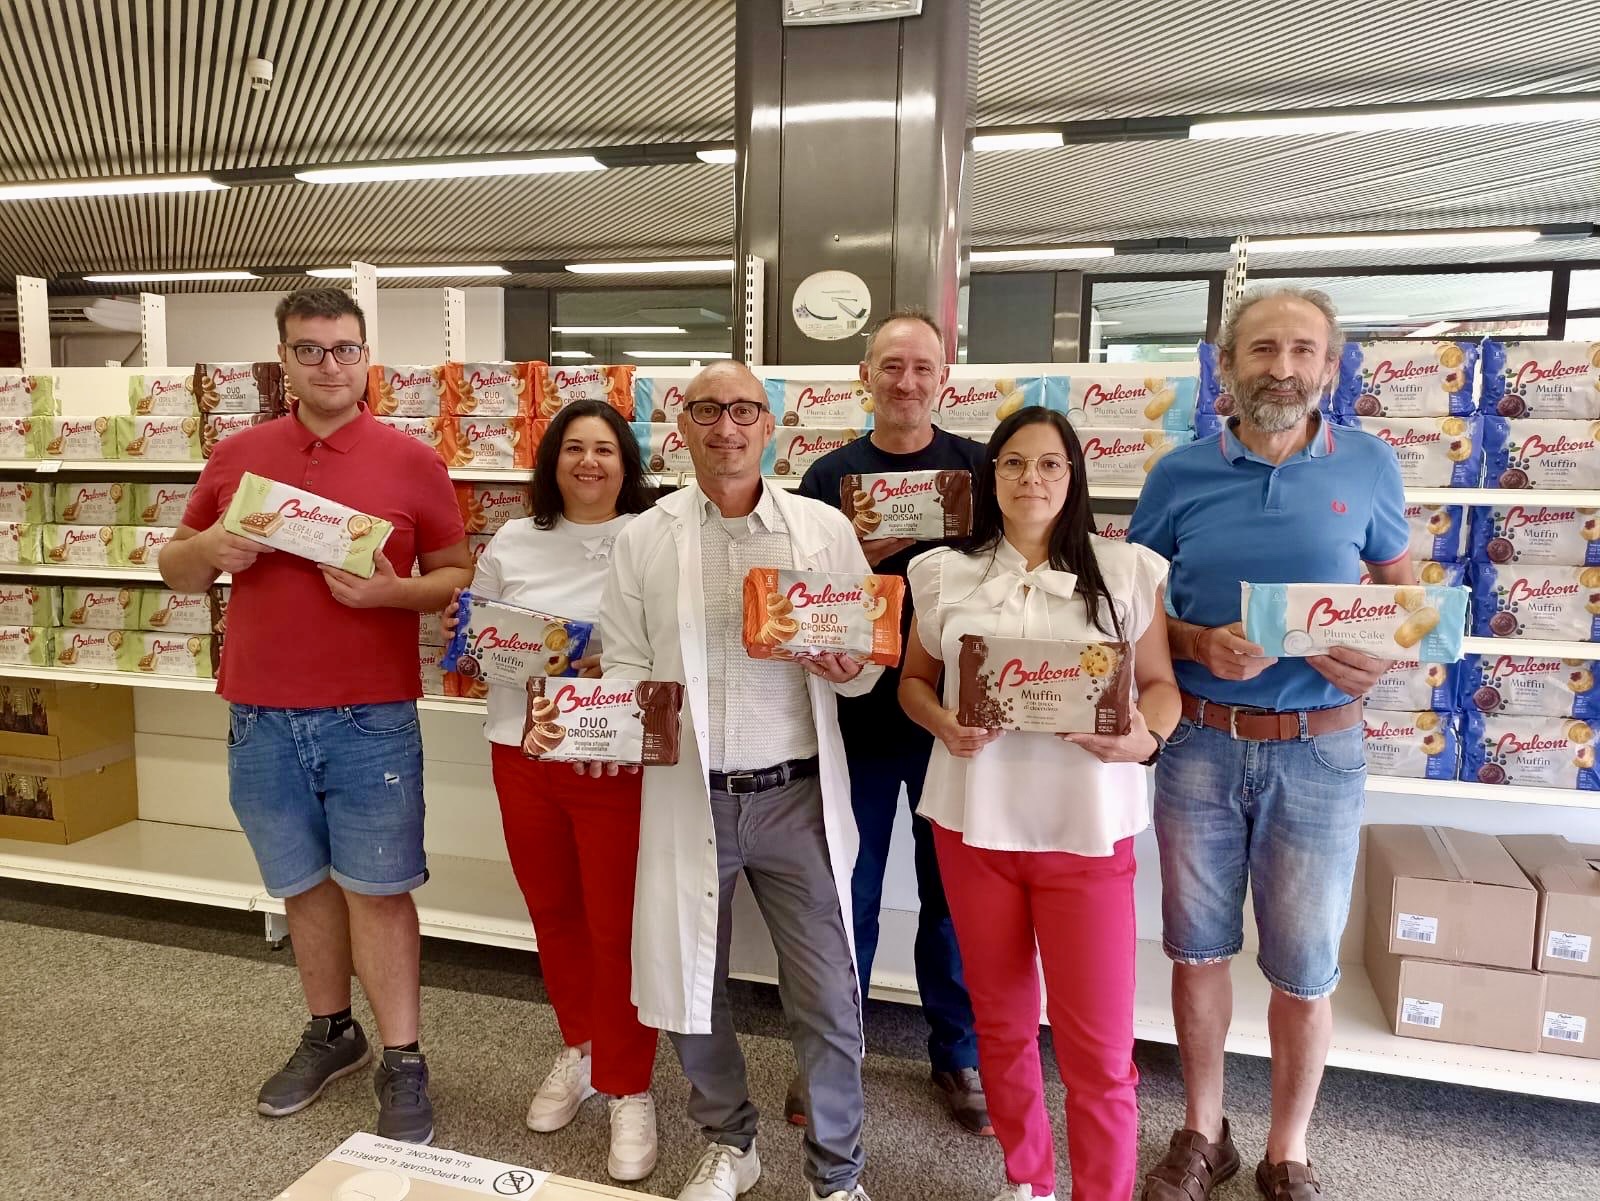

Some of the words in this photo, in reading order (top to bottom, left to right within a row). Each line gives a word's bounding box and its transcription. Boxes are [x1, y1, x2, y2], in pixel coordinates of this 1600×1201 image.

[212, 368, 251, 386] Balconi
[390, 370, 431, 391] Balconi
[469, 369, 512, 390] Balconi
[554, 367, 600, 388] Balconi
[1371, 360, 1439, 392] Balconi
[1515, 360, 1589, 392] Balconi
[484, 391, 500, 399] DUO
[570, 391, 586, 399] DUO
[1389, 384, 1423, 393] Muffin
[1535, 384, 1573, 393] Muffin
[796, 387, 852, 413] Balconi
[938, 386, 998, 414] Balconi
[1082, 383, 1146, 413] Balconi
[1094, 407, 1117, 415] Plume
[1118, 407, 1138, 415] Cake
[61, 422, 92, 437] Balconi
[144, 422, 178, 437] Balconi
[214, 417, 250, 433] Balconi
[466, 424, 507, 442] Balconi
[788, 435, 844, 460] Balconi
[1083, 438, 1146, 460] Balconi
[1520, 434, 1594, 462] Balconi
[1092, 461, 1116, 469] Plume
[1117, 461, 1137, 469] Cake
[1539, 459, 1577, 469] Muffin
[869, 478, 934, 502] Balconi
[480, 491, 521, 508] Balconi
[277, 499, 344, 526] Balconi
[495, 510, 510, 518] DUO
[892, 504, 914, 513] DUO
[883, 513, 923, 522] CROISSANT
[1504, 506, 1576, 533] Balconi
[1524, 529, 1559, 539] Muffin
[786, 582, 864, 609] Balconi
[1508, 578, 1579, 609] Balconi
[1307, 597, 1397, 634] Balconi
[1527, 602, 1562, 613] Muffin
[811, 613, 838, 624] DUO
[801, 623, 849, 634] CROISSANT
[1323, 629, 1357, 640] Plume
[1359, 629, 1385, 640] Cake
[474, 627, 544, 652] Balconi
[491, 652, 524, 668] Muffin
[998, 658, 1081, 693] Balconi
[1492, 655, 1560, 682] Balconi
[1511, 678, 1545, 689] Muffin
[554, 685, 634, 713] Balconi
[1021, 689, 1062, 702] Muffin
[580, 717, 608, 728] DUO
[567, 728, 618, 739] CROISSANT
[1366, 742, 1401, 754] Muffin
[1496, 732, 1568, 759] Balconi
[1516, 756, 1551, 767] Muffin
[340, 1148, 388, 1164] CARRELLO
[389, 1158, 397, 1166] IL
[398, 1161, 461, 1180] APPOGGIARE
[455, 1160, 473, 1169] SUL
[461, 1175, 485, 1185] NON
